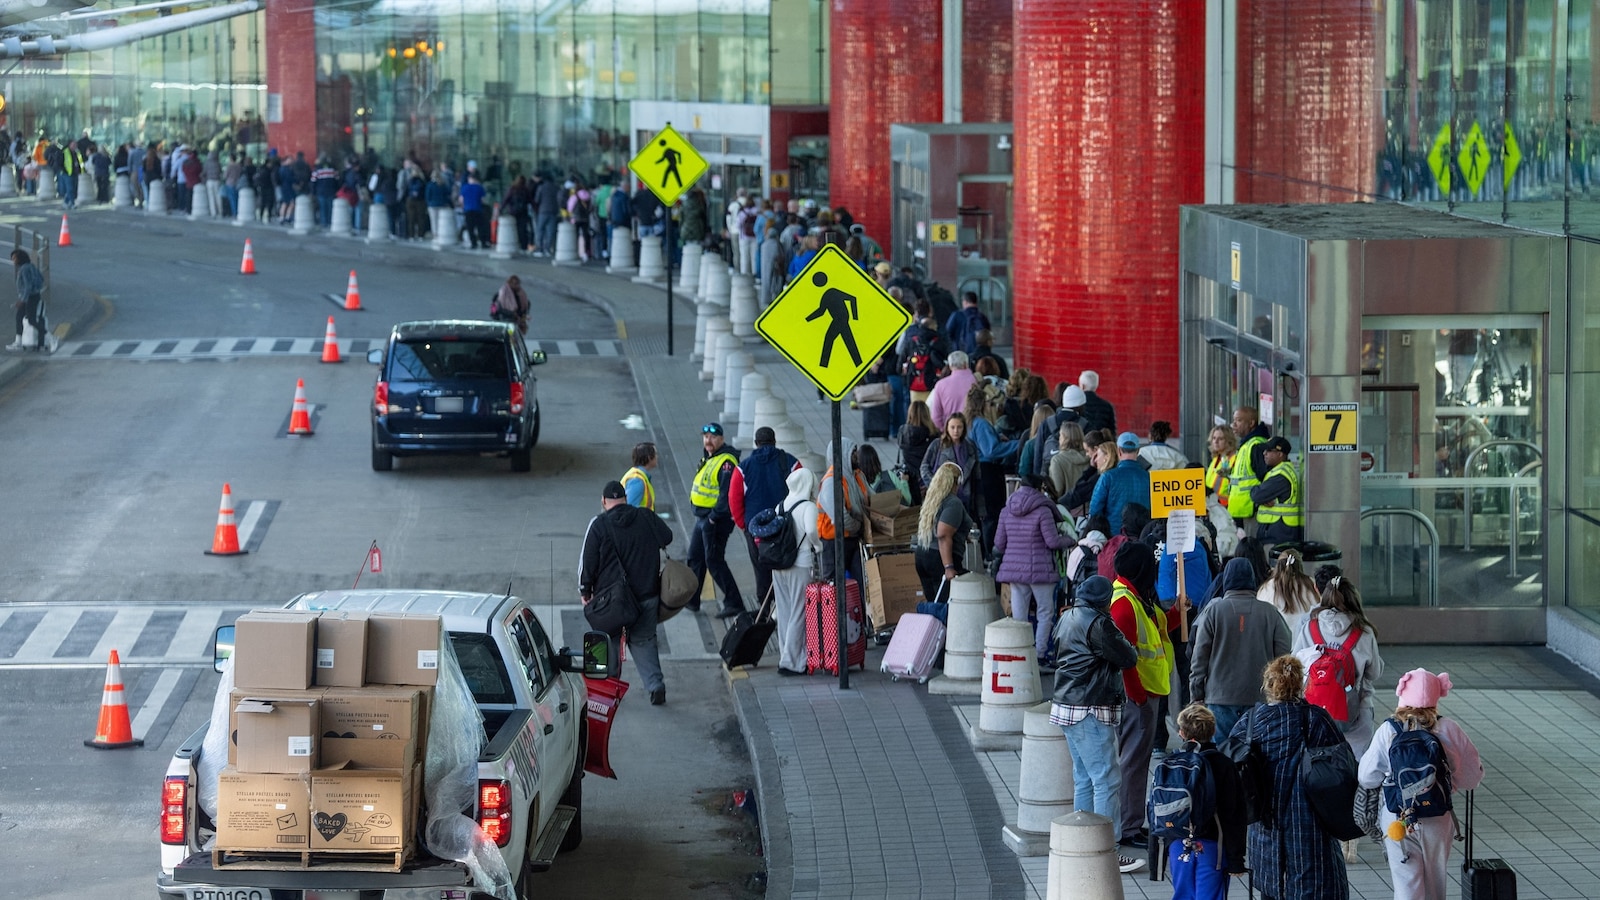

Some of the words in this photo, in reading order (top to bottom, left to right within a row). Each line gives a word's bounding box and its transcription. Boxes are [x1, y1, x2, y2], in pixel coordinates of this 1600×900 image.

[940, 225, 948, 240] 8
[1325, 414, 1342, 442] 7
[1153, 480, 1180, 492] END
[1184, 479, 1203, 490] OF
[1163, 495, 1193, 507] LINE
[318, 817, 341, 826] BAKED
